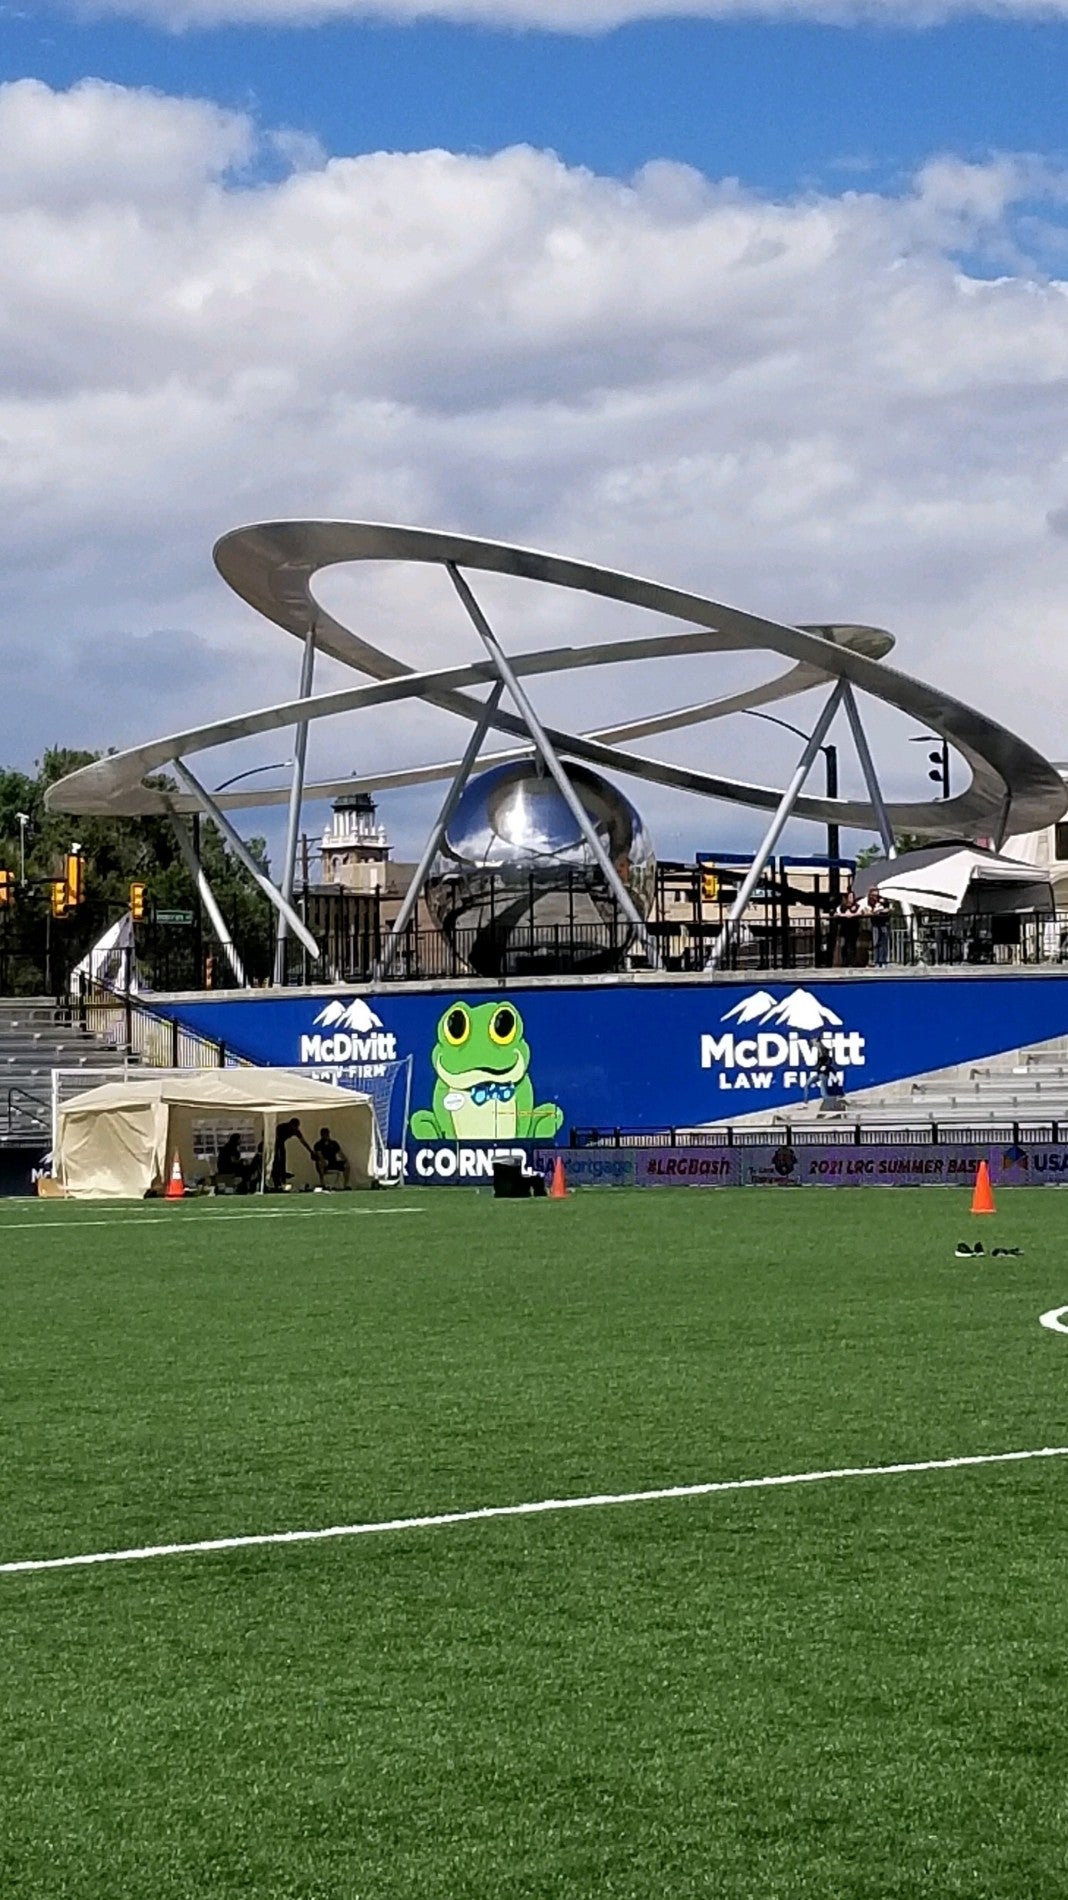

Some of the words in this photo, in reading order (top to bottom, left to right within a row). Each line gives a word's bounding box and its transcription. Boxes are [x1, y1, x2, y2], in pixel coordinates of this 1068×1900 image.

[301, 1032, 397, 1062] McDivitt
[701, 1031, 866, 1068] McDivitt
[348, 1064, 387, 1079] FIRM
[719, 1072, 774, 1089] LAW
[810, 1160, 843, 1174] 2021
[847, 1160, 874, 1174] LRG
[878, 1159, 943, 1174] SUMMER
